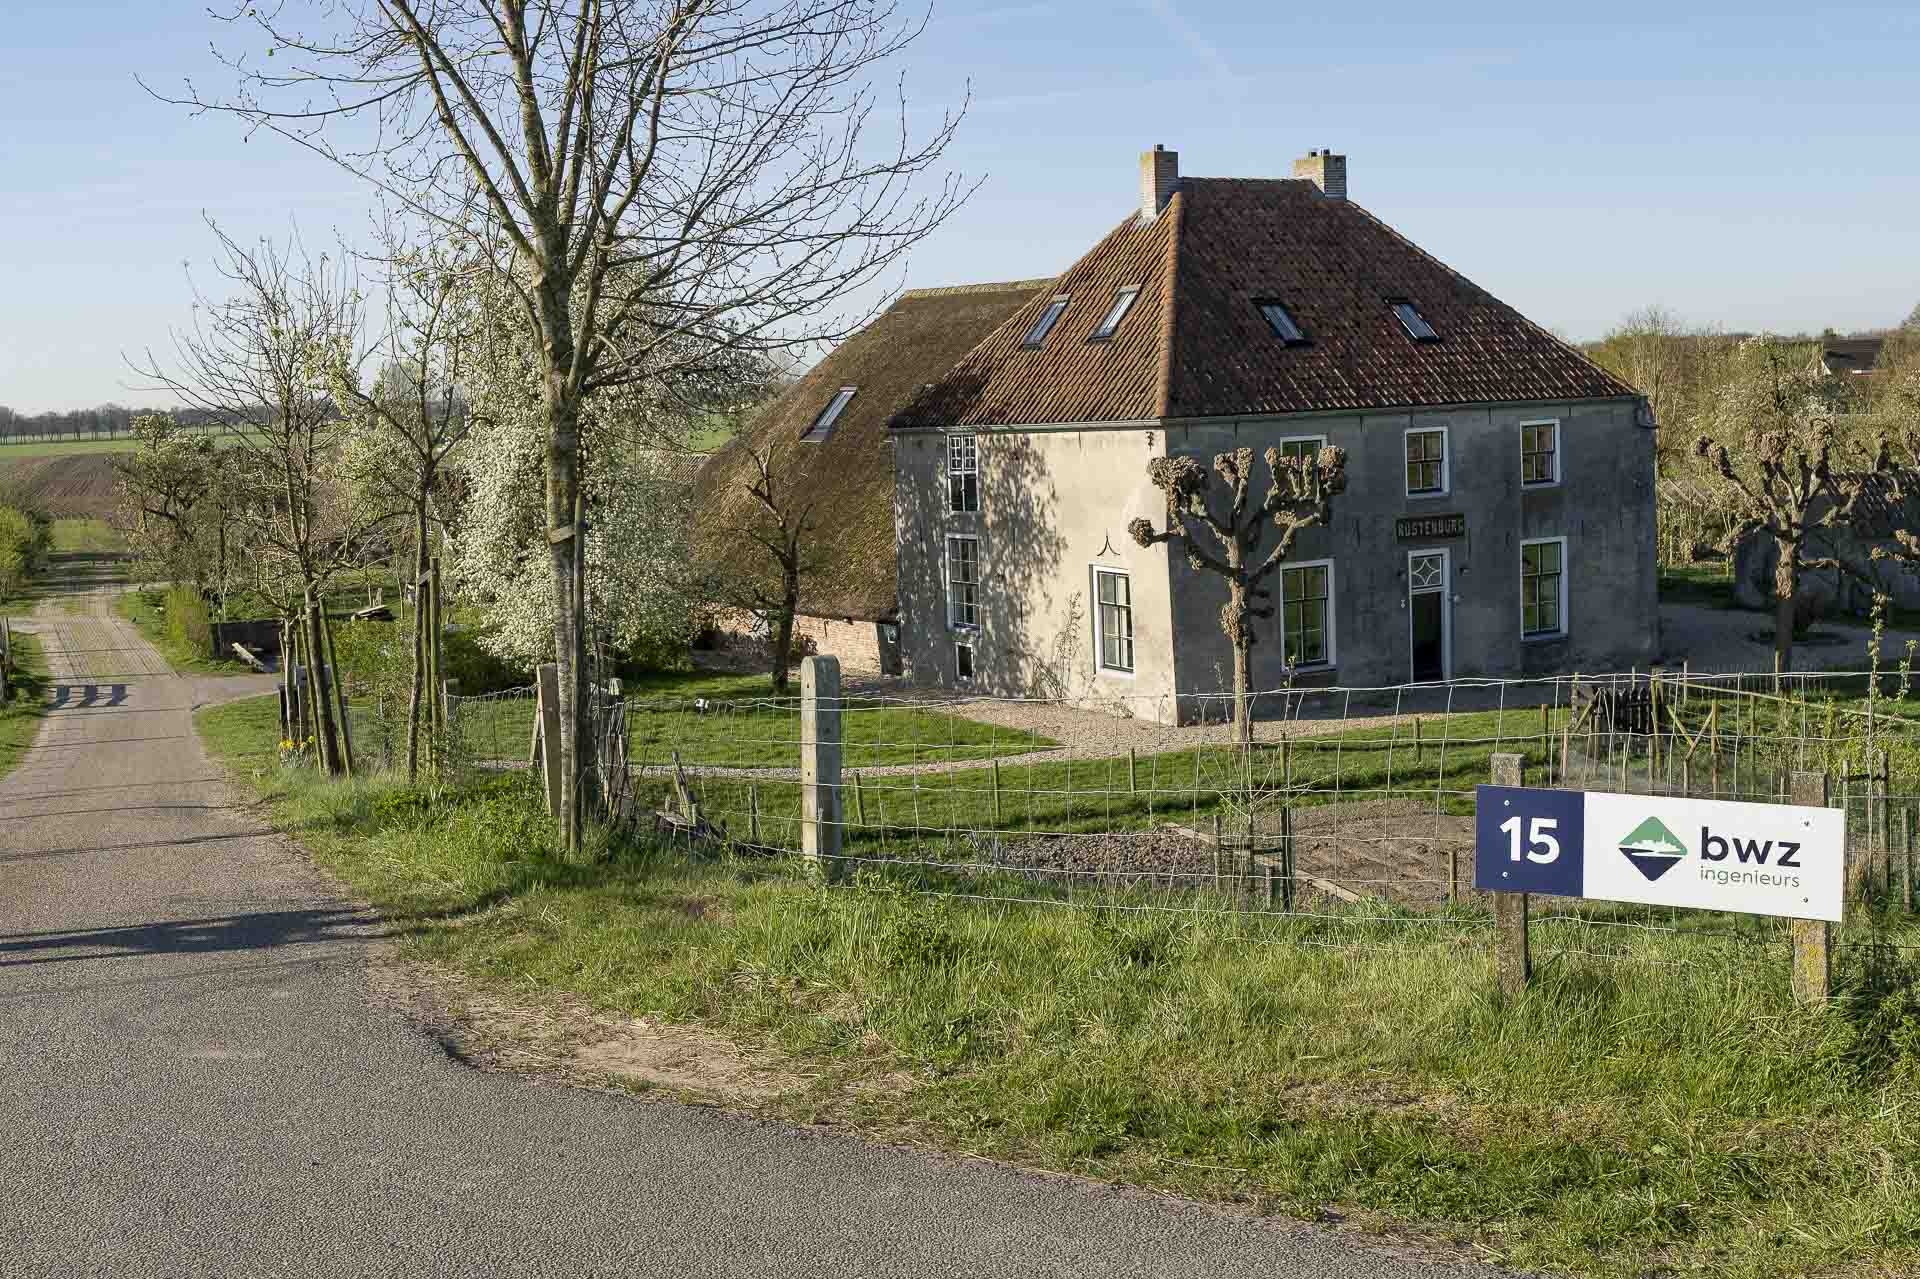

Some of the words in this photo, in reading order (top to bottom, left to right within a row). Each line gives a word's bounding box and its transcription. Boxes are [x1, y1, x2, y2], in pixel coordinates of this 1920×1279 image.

[1500, 816, 1560, 864] 15
[1700, 826, 1801, 867] bwz
[1700, 865, 1800, 888] ingenieurs
